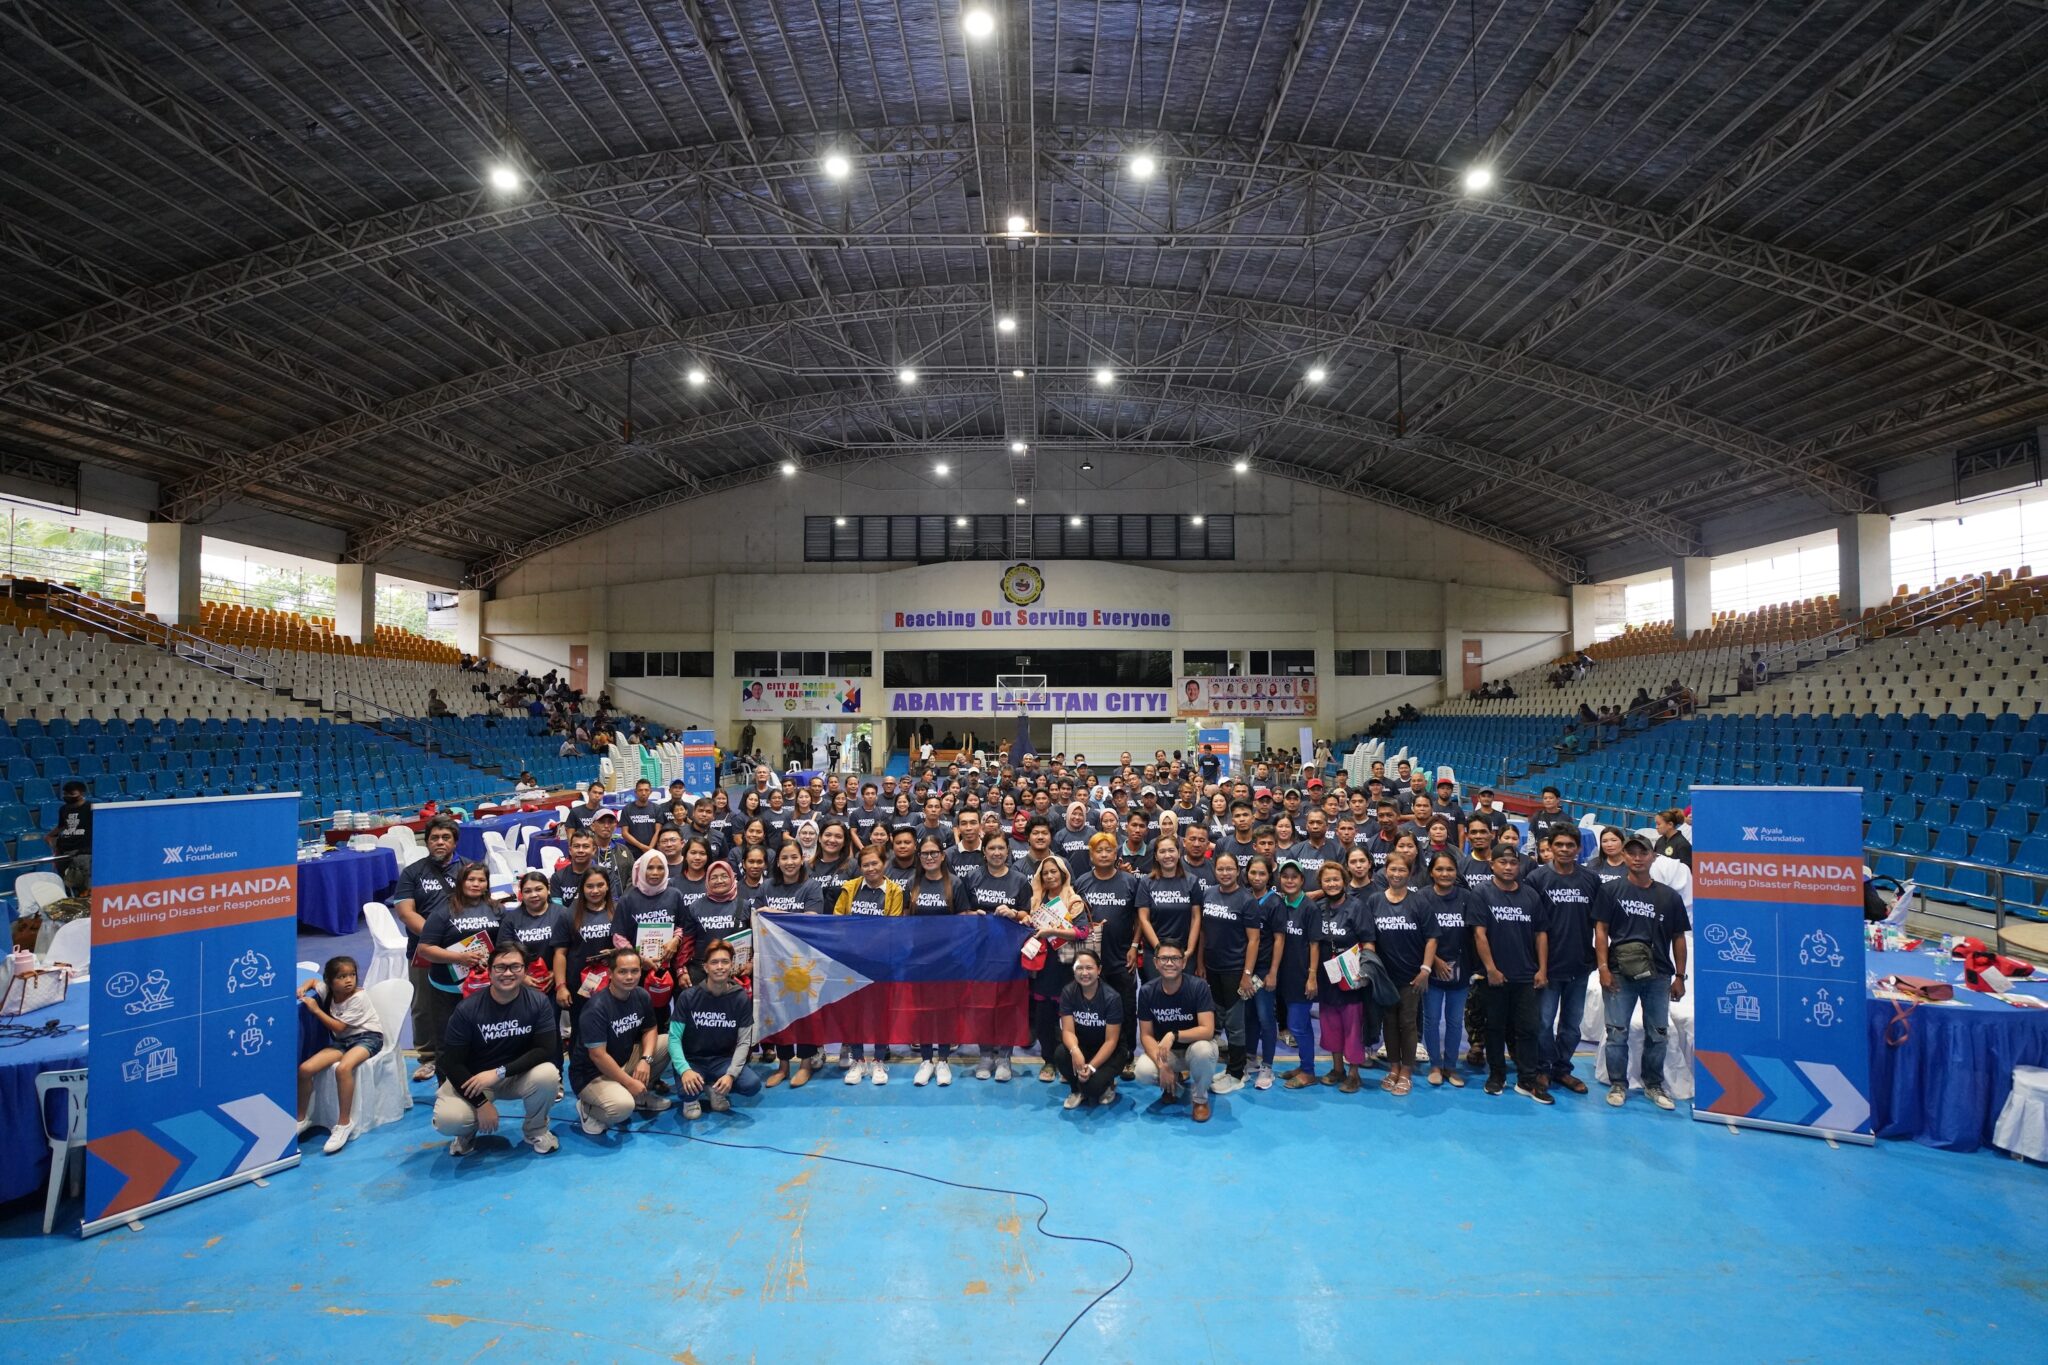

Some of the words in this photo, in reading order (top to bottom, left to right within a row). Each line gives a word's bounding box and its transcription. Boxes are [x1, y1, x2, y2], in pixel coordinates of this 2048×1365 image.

[895, 611, 975, 628] Reaching
[982, 610, 1011, 626] Out
[1017, 610, 1087, 627] Serving
[1093, 610, 1170, 627] Everyone
[893, 693, 984, 711] ABANTE
[1106, 693, 1167, 711] CITY!
[1761, 827, 1783, 836] Ayala
[1761, 835, 1805, 843] Foundation
[186, 844, 213, 855] Ayala
[185, 850, 237, 862] Foundation
[1699, 861, 1778, 877] MAGING
[1783, 865, 1856, 880] HANDA
[1699, 877, 1747, 889] Upskilling
[1749, 879, 1792, 890] Disaster
[1794, 881, 1857, 893] Responders
[102, 886, 205, 914] MAGING
[211, 876, 291, 899] HANDA
[1552, 895, 1589, 904] MAGITING
[978, 896, 1016, 905] MAGITING
[770, 902, 805, 910] MAGITING
[1203, 903, 1229, 912] MAGING
[1492, 906, 1522, 914] MAGING
[1621, 900, 1655, 912] MAGING
[102, 911, 166, 928] Upskilling
[169, 904, 221, 919] Disaster
[224, 895, 291, 914] Responders
[636, 909, 668, 920] MAGING
[1203, 909, 1237, 920] MAGITING
[453, 916, 489, 924] MAGING
[700, 915, 733, 923] MAGING
[1375, 916, 1406, 924] MAGING
[1495, 913, 1532, 922] MAGITING
[517, 926, 552, 936] MAGING
[693, 1011, 726, 1020] MAGING
[482, 1020, 519, 1030] MAGING
[697, 1019, 737, 1028] MAGITING
[484, 1025, 532, 1040] MAGITING
